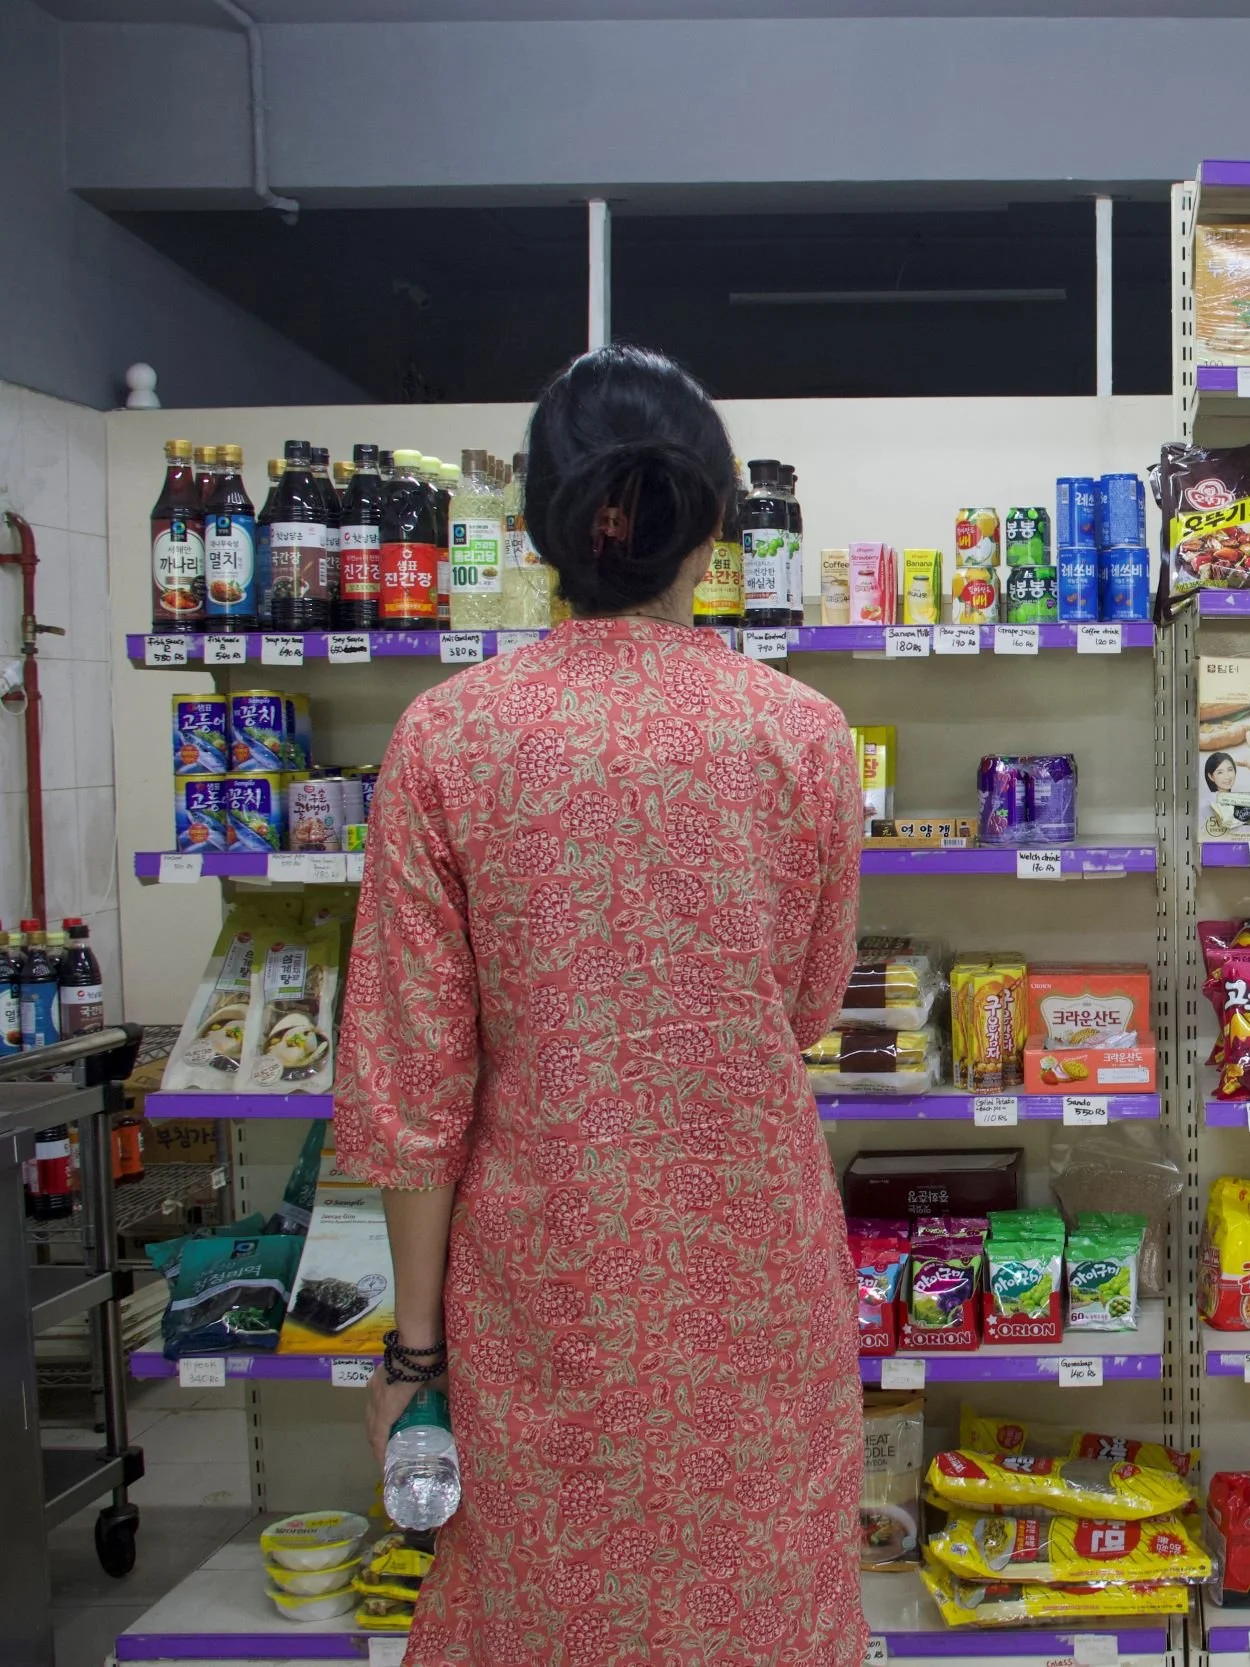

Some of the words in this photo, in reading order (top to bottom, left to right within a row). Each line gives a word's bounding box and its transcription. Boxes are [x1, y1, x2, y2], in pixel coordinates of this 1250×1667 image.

[1192, 494, 1228, 505] 오뚜기
[1185, 504, 1246, 531] 오뚜기
[1006, 520, 1036, 539] 봉봉
[958, 534, 971, 547] 배
[209, 551, 238, 570] 멸치
[271, 551, 301, 565] 국간장
[396, 560, 418, 571] 샘표
[712, 559, 731, 570] 샘표
[823, 561, 849, 569] Coffee
[906, 560, 933, 568] Banana
[159, 557, 199, 575] 까나리
[1061, 562, 1095, 577] 레쓰비
[1111, 562, 1143, 578] 레쓰비
[384, 572, 433, 587] 진간장
[452, 566, 478, 586] 100
[747, 578, 775, 589] 매실청
[1016, 580, 1047, 599] 봉봉
[972, 593, 987, 607] 배
[896, 640, 912, 652] 180
[197, 704, 212, 712] 샘표
[182, 713, 225, 733] 고등어
[240, 705, 275, 729] 꽁치
[230, 788, 261, 809] 꽁치
[900, 823, 951, 838] 연양갱
[1051, 1009, 1122, 1027] 크라운산도
[983, 994, 1001, 1059] 구운감자
[1102, 1052, 1144, 1063] 크라운산도
[1067, 1098, 1091, 1106] Sando
[1095, 1108, 1106, 1116] Rs
[333, 1199, 365, 1207] Sempio
[908, 1190, 949, 1203] 중화춘장
[914, 1266, 964, 1293] 마이구미
[994, 1268, 1043, 1293] 마이구미
[1070, 1260, 1120, 1289] 마이구미
[1071, 1312, 1084, 1322] 60
[997, 1322, 1056, 1337] ORION
[914, 1331, 971, 1345] ORION
